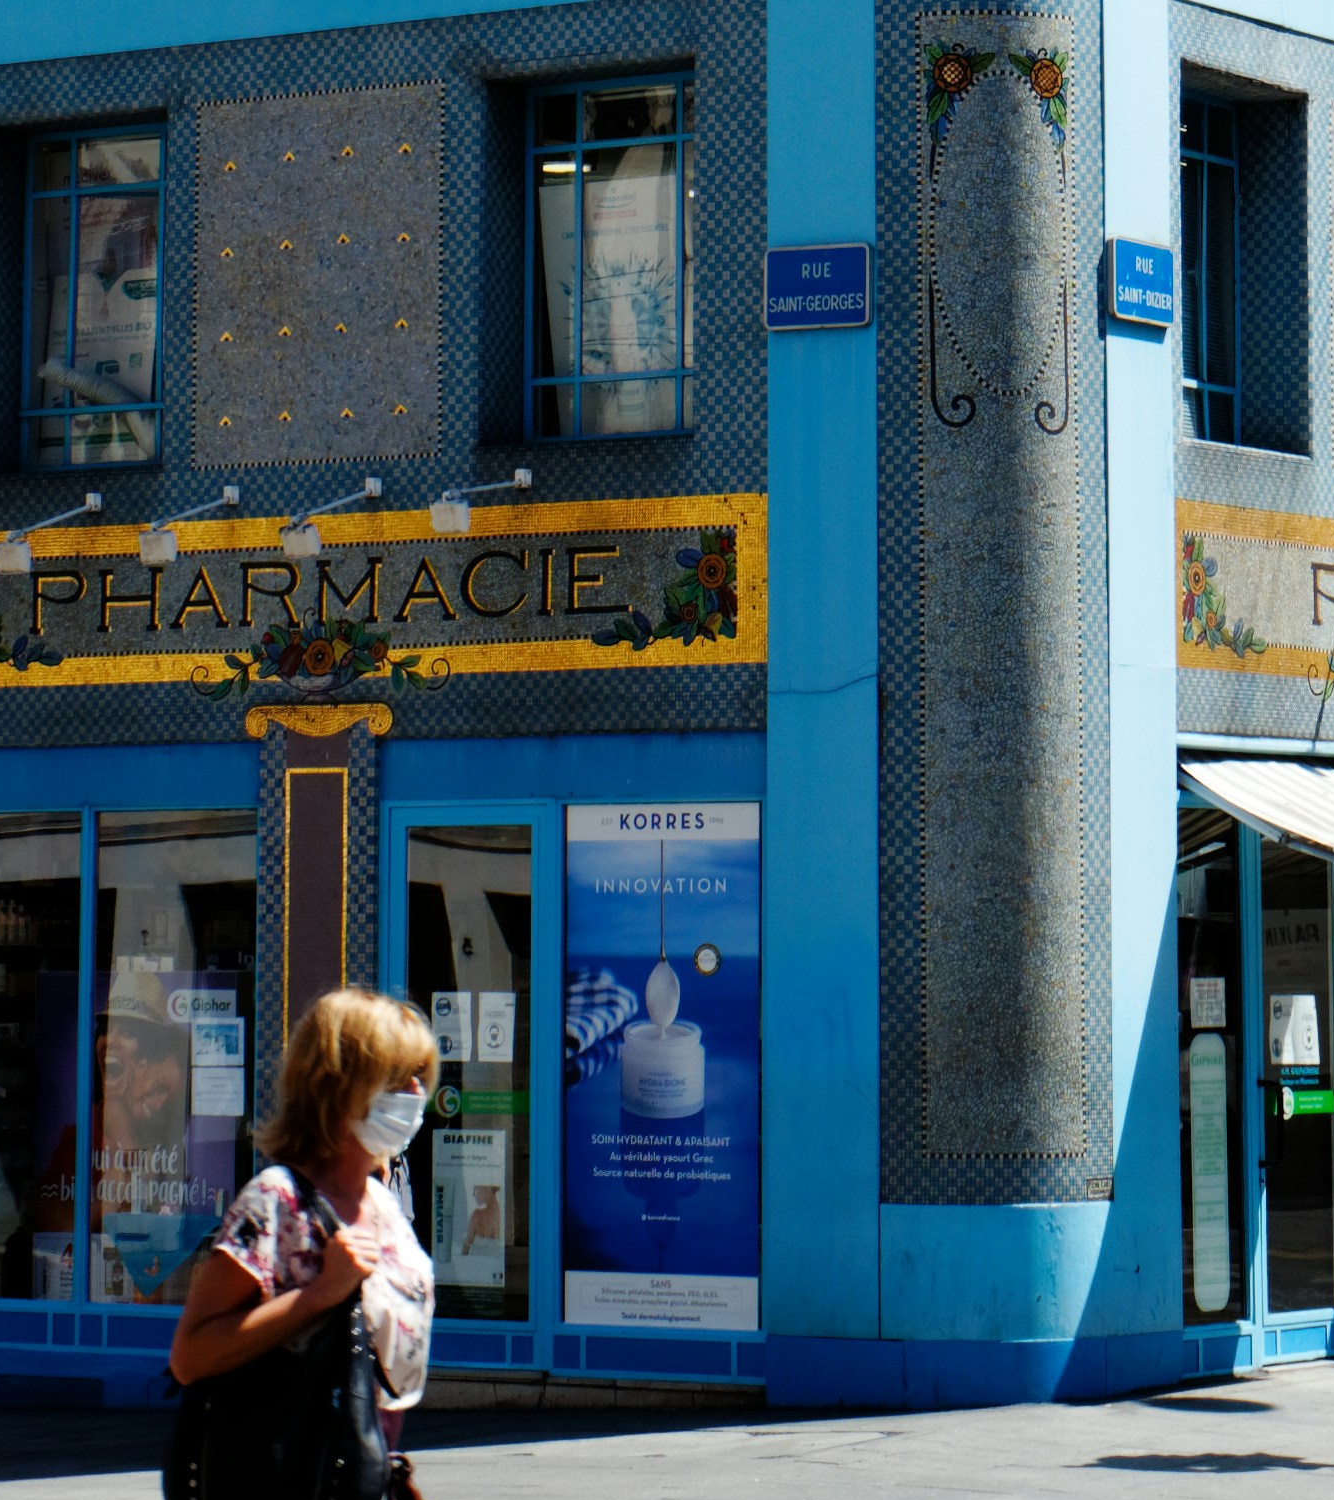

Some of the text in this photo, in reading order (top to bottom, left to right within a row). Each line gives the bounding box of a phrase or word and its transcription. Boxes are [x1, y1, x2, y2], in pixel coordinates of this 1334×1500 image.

[801, 262, 831, 278] RUE
[1135, 256, 1154, 275] RUE
[769, 292, 864, 313] SAINT-GEORGES
[1118, 284, 1172, 311] SAINT-DIZIER
[29, 545, 634, 636] PHARMACIE
[620, 812, 705, 830] KORRES
[595, 877, 728, 894] INNOVATION
[191, 997, 231, 1012] Giphar
[443, 1134, 493, 1144] BIAFINE
[591, 1134, 731, 1147] SOIN HYDRATANT & APAISANT
[610, 1152, 714, 1164] Au véritable yaourt Grec
[593, 1167, 731, 1183] Source naturelle de probiotiques
[435, 1184, 444, 1243] BIAFINE
[650, 1279, 672, 1289] SANS
